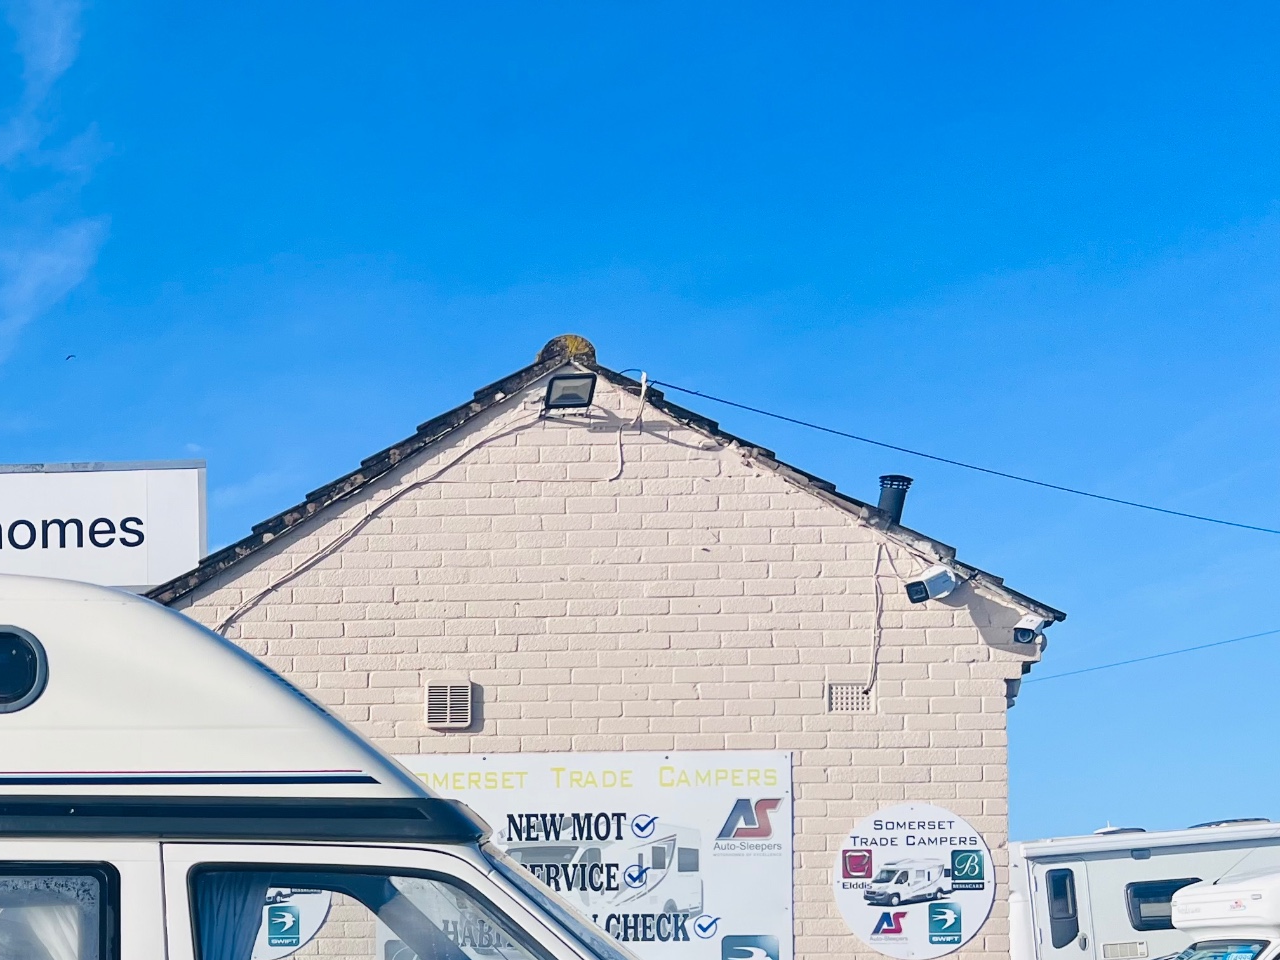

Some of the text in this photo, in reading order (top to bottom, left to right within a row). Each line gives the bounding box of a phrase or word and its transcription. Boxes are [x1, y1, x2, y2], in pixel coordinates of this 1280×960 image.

[550, 767, 634, 788] TRADE
[658, 766, 778, 788] CAMPERS
[506, 812, 627, 842] NEW MOT
[873, 819, 956, 831] SOMERSET
[713, 842, 782, 852] Auto-Sleepers
[850, 835, 978, 847] TRADE CAMPERS
[521, 863, 620, 892] ERVICE
[605, 913, 691, 942] CHECK
